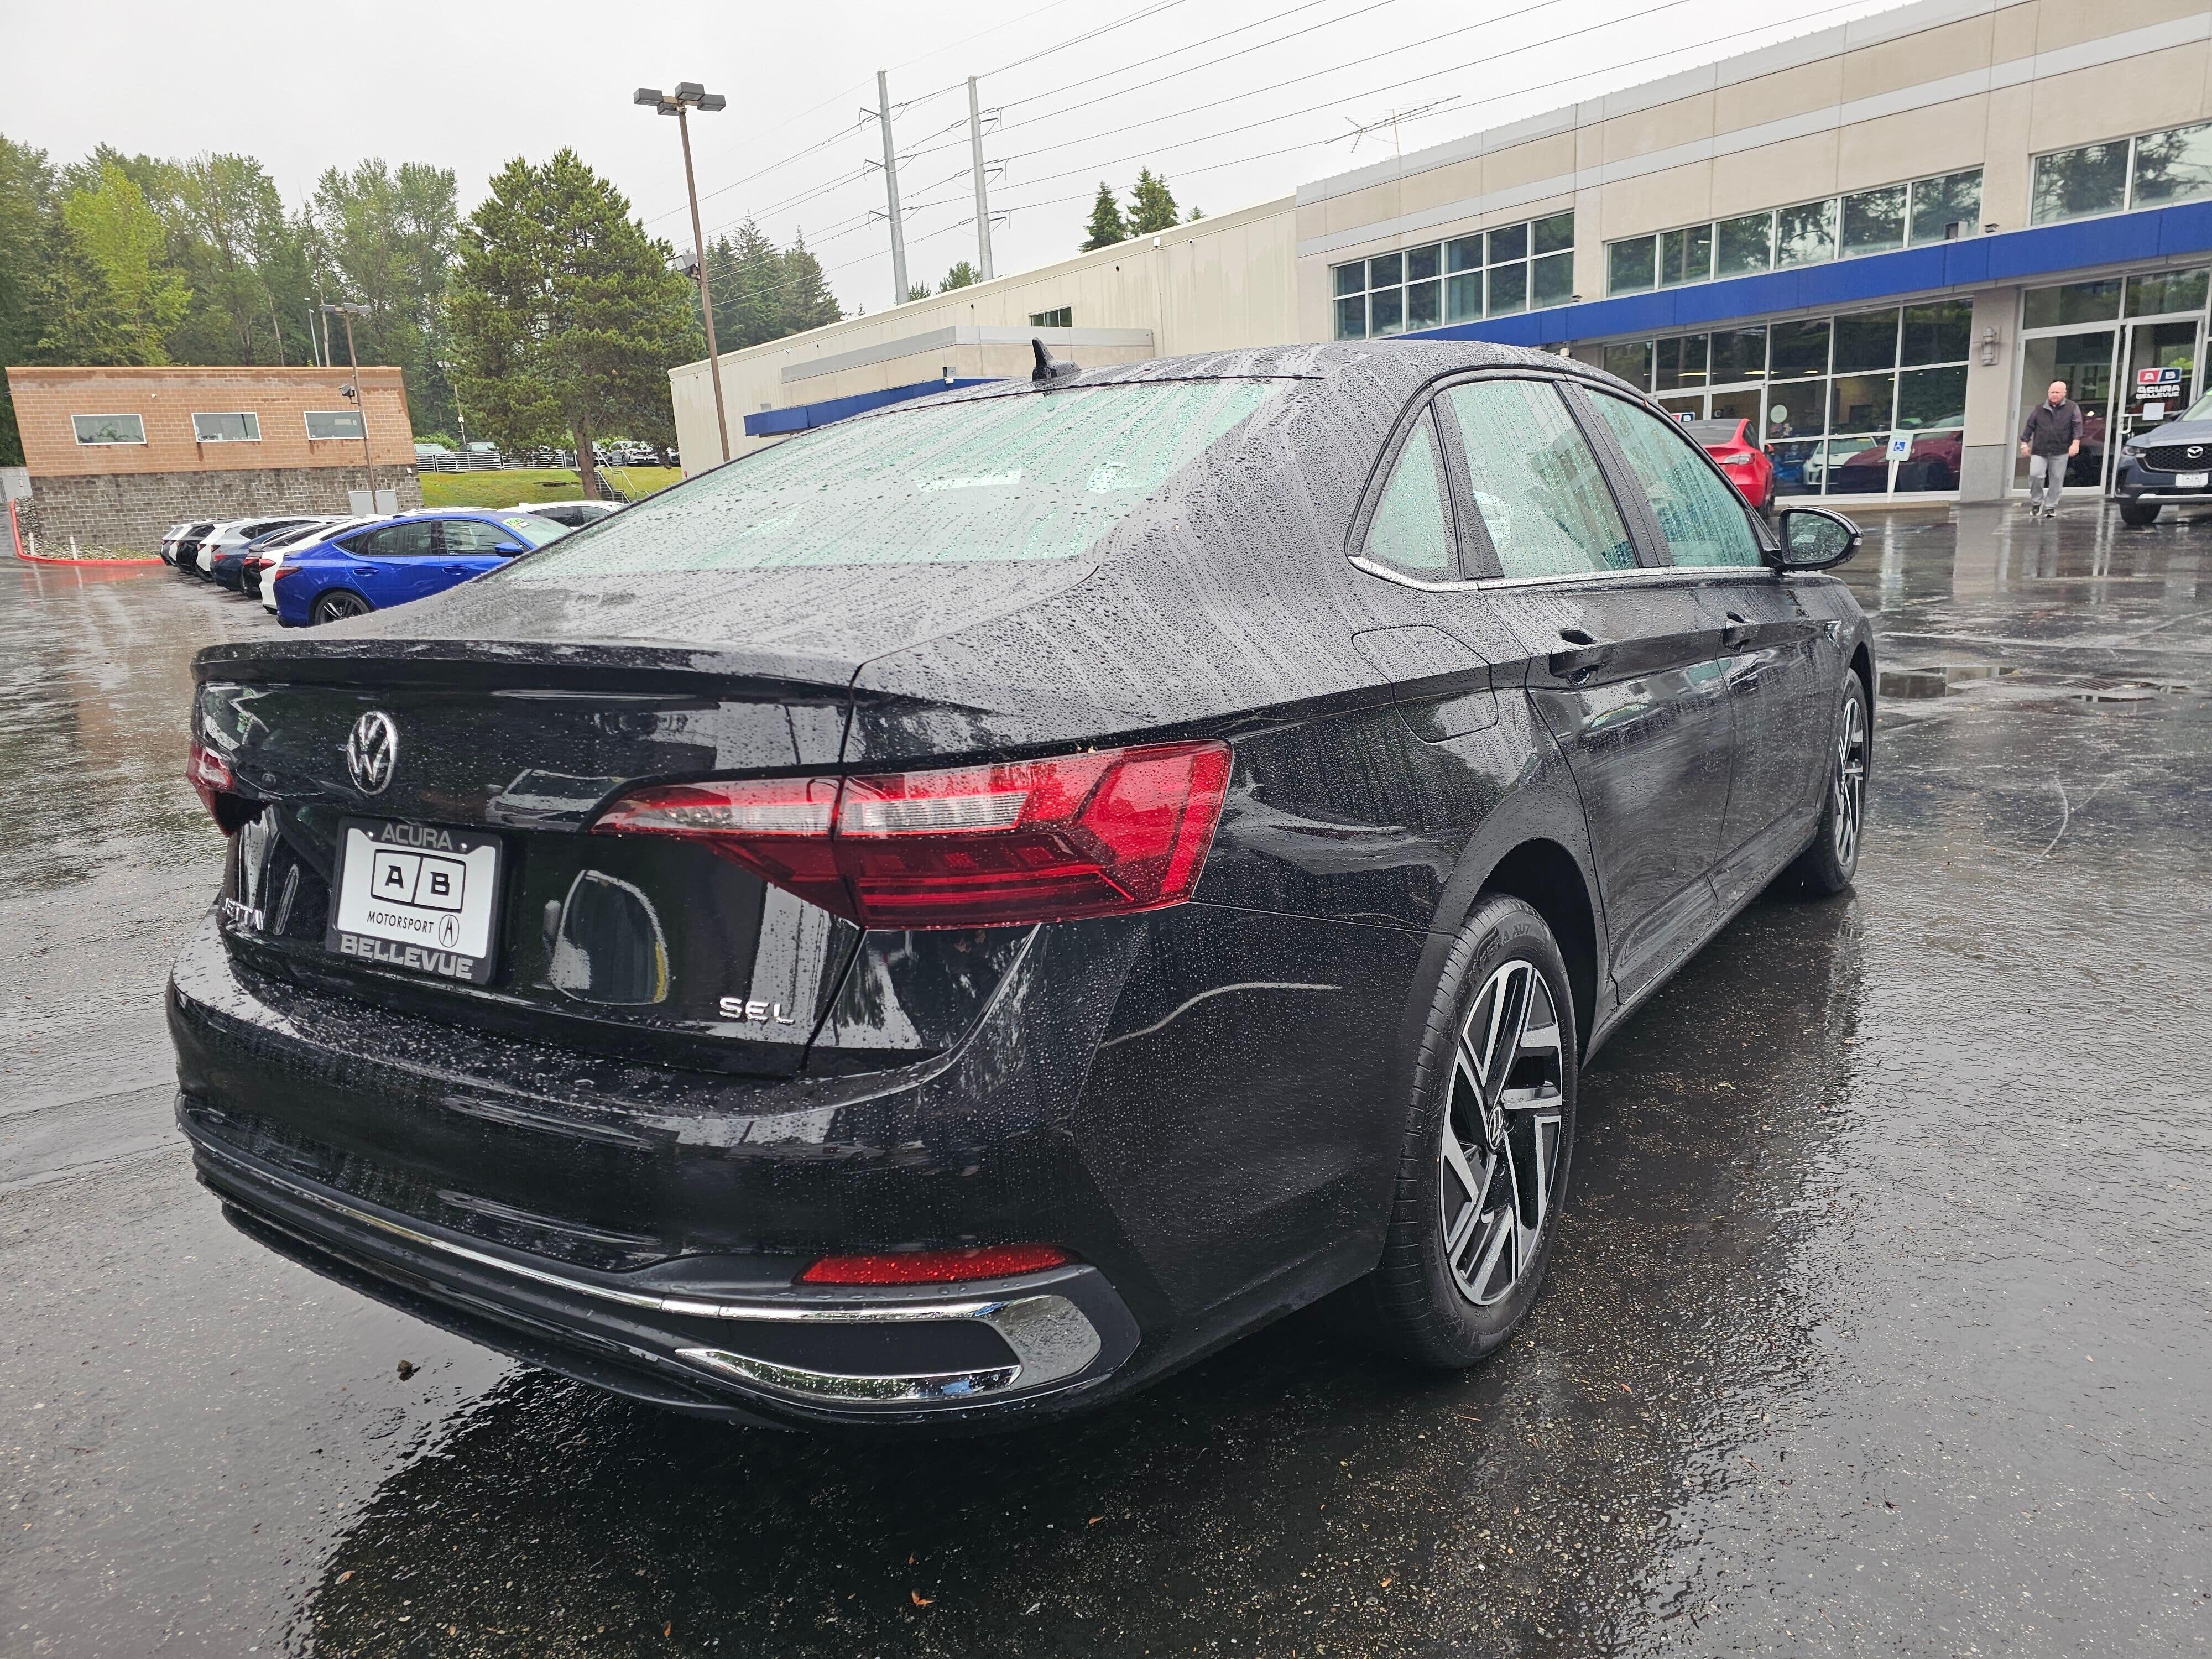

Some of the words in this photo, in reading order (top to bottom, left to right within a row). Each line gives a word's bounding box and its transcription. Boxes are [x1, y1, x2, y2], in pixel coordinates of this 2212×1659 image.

[2137, 385, 2180, 393] ACURA
[2143, 372, 2154, 380] A
[2165, 371, 2176, 379] B
[380, 823, 453, 851] ACURA
[384, 865, 404, 889] A
[430, 871, 450, 896] B
[367, 911, 434, 934] MOTORSPORT
[340, 933, 473, 979] BELLEVUE
[719, 997, 795, 1024] SEL
